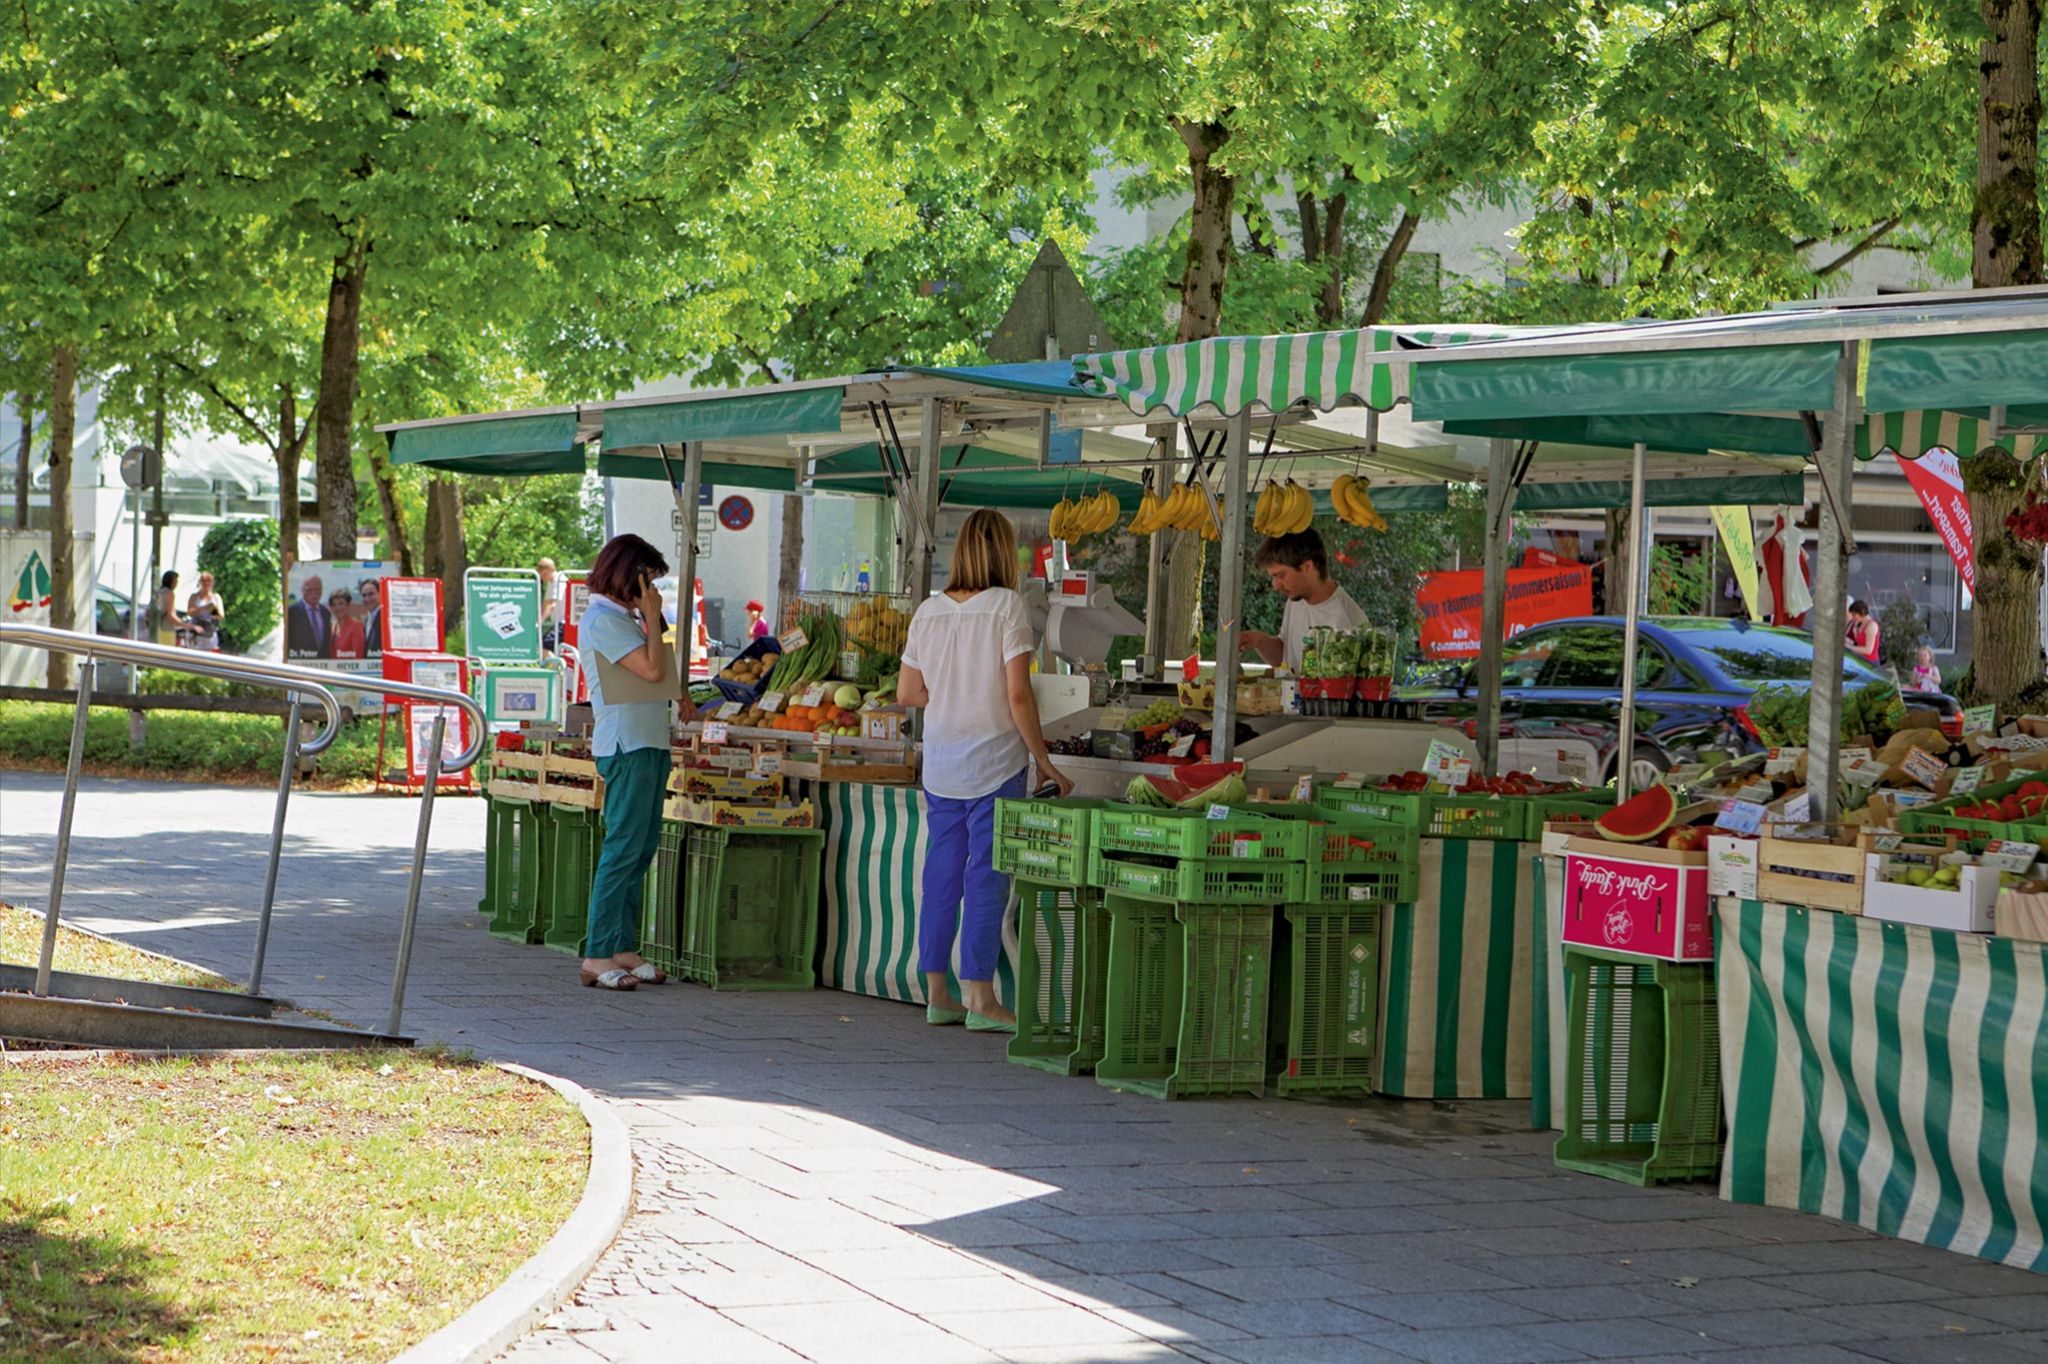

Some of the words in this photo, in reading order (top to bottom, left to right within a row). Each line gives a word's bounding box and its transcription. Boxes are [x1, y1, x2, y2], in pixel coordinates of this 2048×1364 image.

[1453, 628, 1469, 639] Alle
[337, 663, 360, 671] MEYER
[367, 663, 383, 671] LOR
[1575, 860, 1617, 896] Lady
[1615, 874, 1668, 901] Pink
